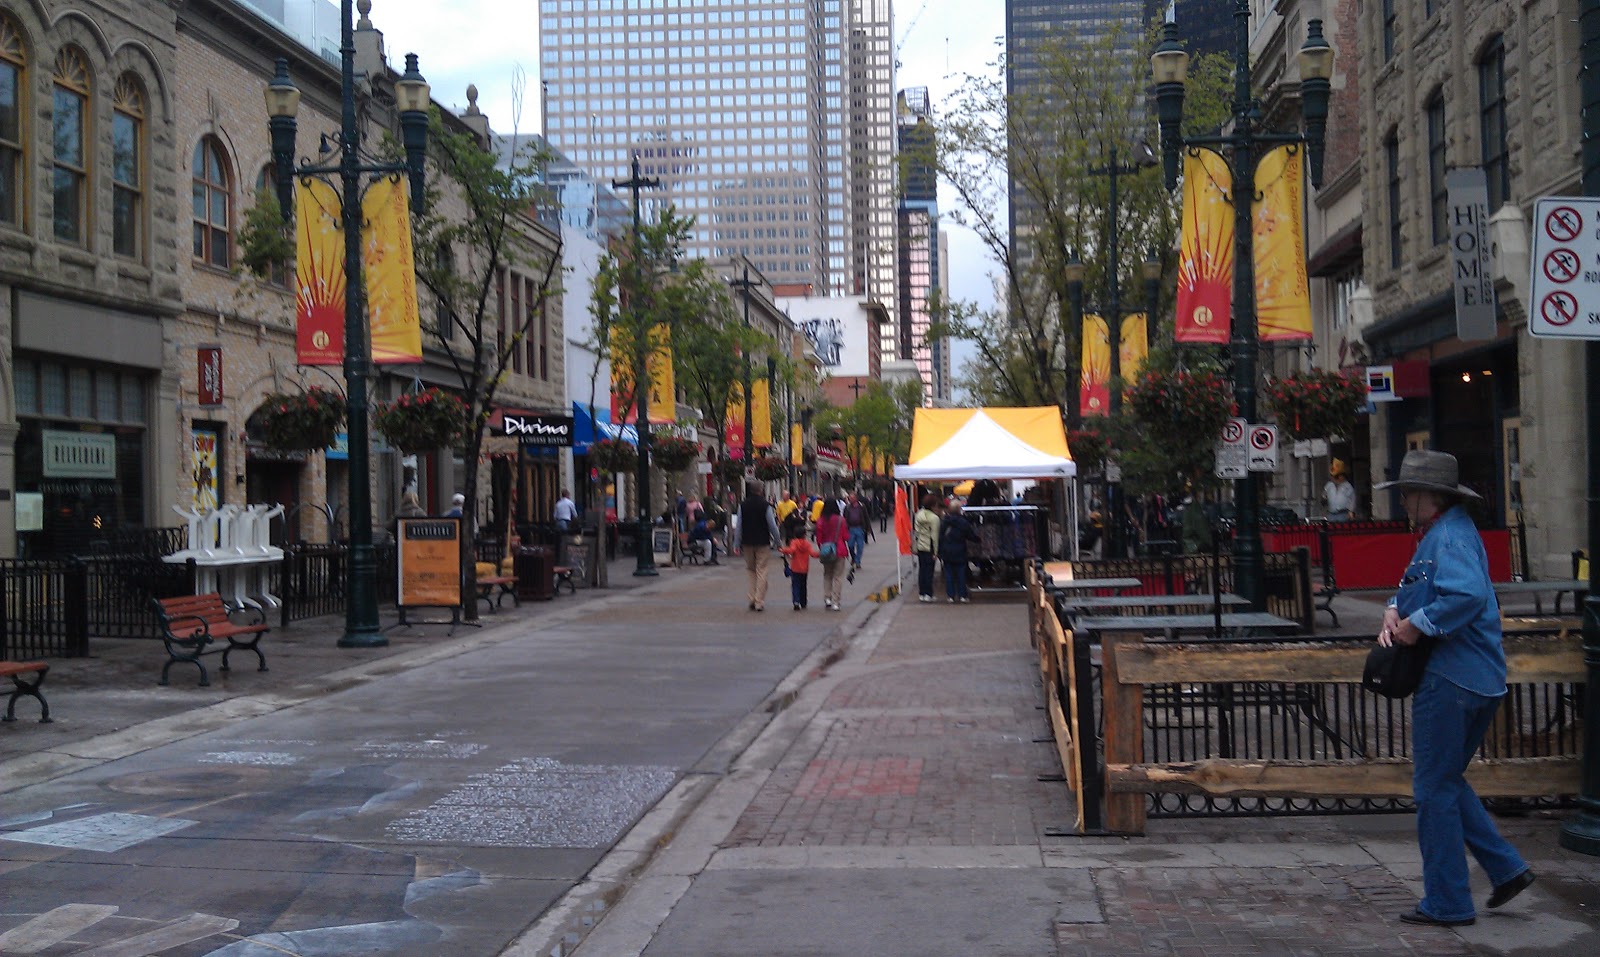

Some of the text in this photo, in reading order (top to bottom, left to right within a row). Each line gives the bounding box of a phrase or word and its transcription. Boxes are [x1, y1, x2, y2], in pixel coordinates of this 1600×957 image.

[1287, 186, 1300, 238] Avenue
[396, 217, 409, 265] Avenue
[1454, 205, 1478, 306] HOME
[1293, 240, 1307, 298] Stephen
[54, 445, 106, 464] BELVEDERE
